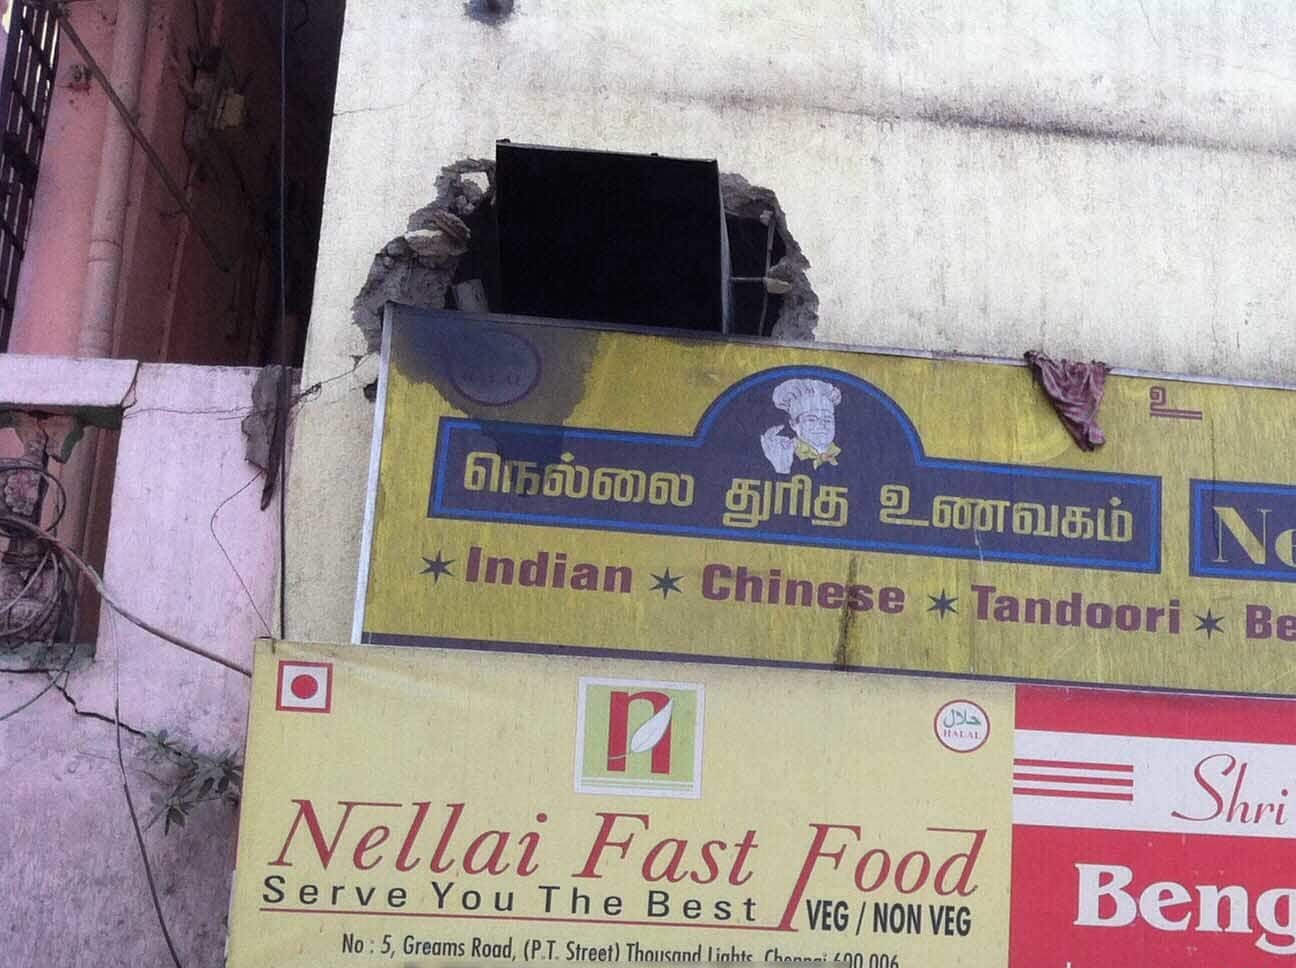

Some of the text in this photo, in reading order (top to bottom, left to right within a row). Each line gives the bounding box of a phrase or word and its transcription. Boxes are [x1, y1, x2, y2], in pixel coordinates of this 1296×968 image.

[463, 450, 1135, 543] நெல்லை துரித உணவகம்
[464, 546, 635, 594] Indian
[700, 562, 907, 615] Chinese
[970, 584, 1182, 635] Tandoori
[942, 728, 982, 740] HALAL
[1170, 753, 1289, 826] Shri
[267, 799, 988, 931] Nellai Fast Food
[262, 874, 758, 922] Serve You The Best
[806, 898, 850, 933] VEG
[873, 901, 923, 934] NON
[929, 903, 972, 937] VEG
[342, 932, 364, 954] No
[381, 933, 396, 959] 5,
[403, 934, 465, 957] Greams
[471, 936, 517, 962] Road,
[566, 940, 620, 963] Street)
[626, 942, 702, 963] Thousand
